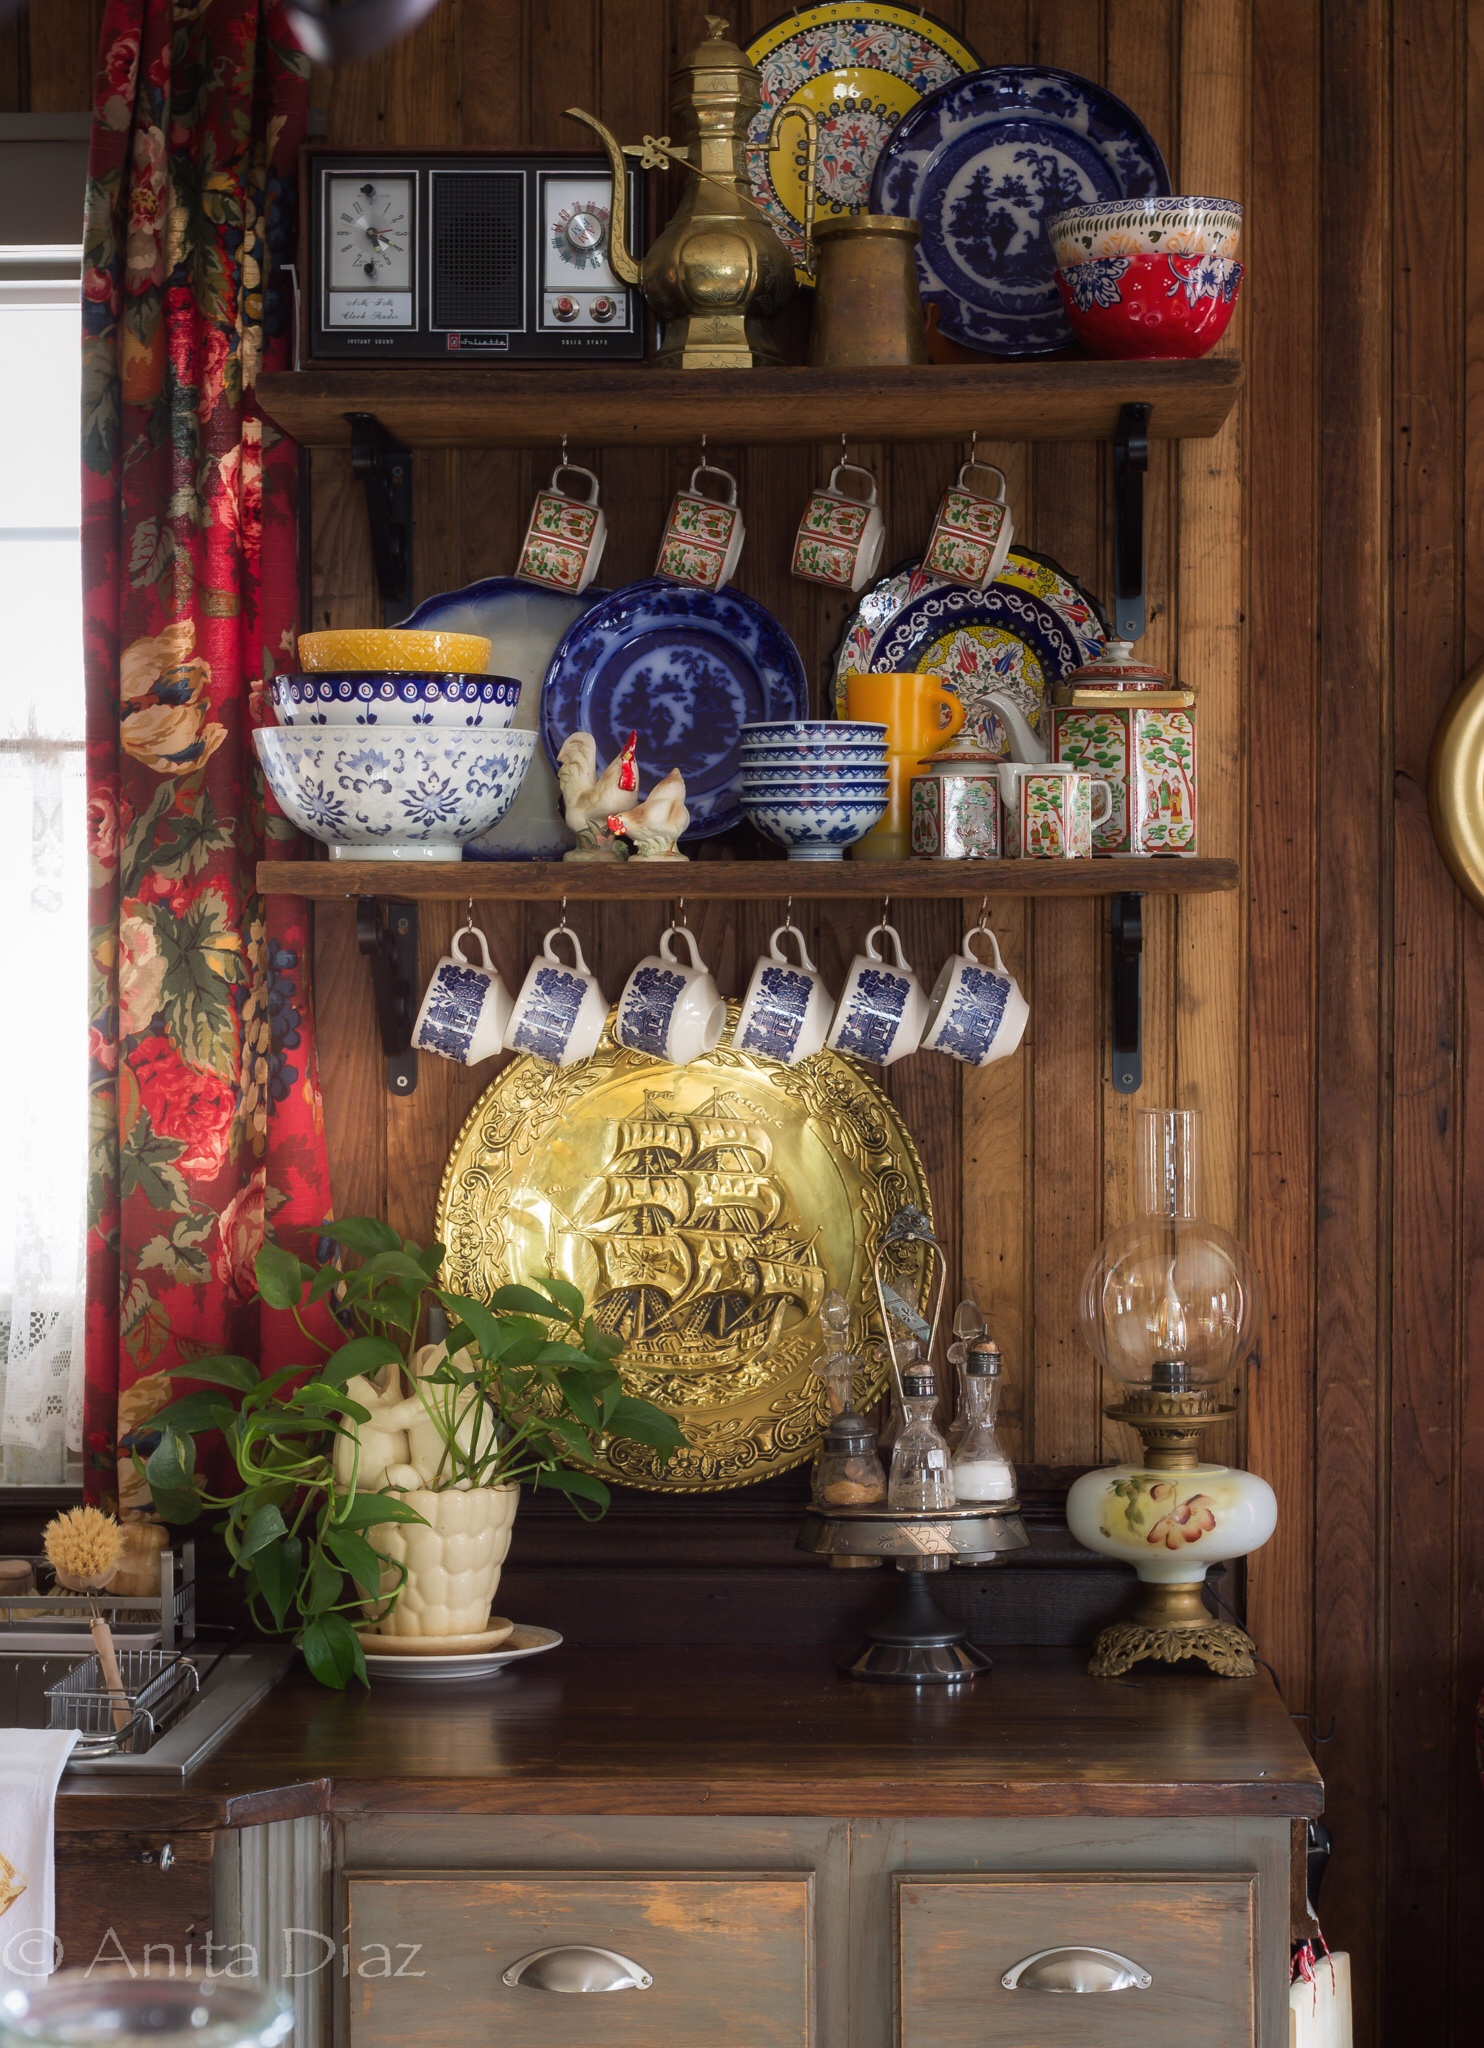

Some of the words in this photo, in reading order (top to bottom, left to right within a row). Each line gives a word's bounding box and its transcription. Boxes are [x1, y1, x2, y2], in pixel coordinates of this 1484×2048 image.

[352, 201, 363, 214] 11
[571, 201, 582, 213] 70
[340, 213, 353, 223] 10
[391, 214, 404, 224] 2
[558, 208, 571, 221] 60
[341, 244, 353, 253] 8
[382, 253, 392, 265] 5
[341, 310, 366, 320] Clock
[370, 310, 399, 320] Radio
[460, 338, 506, 346] Juliette
